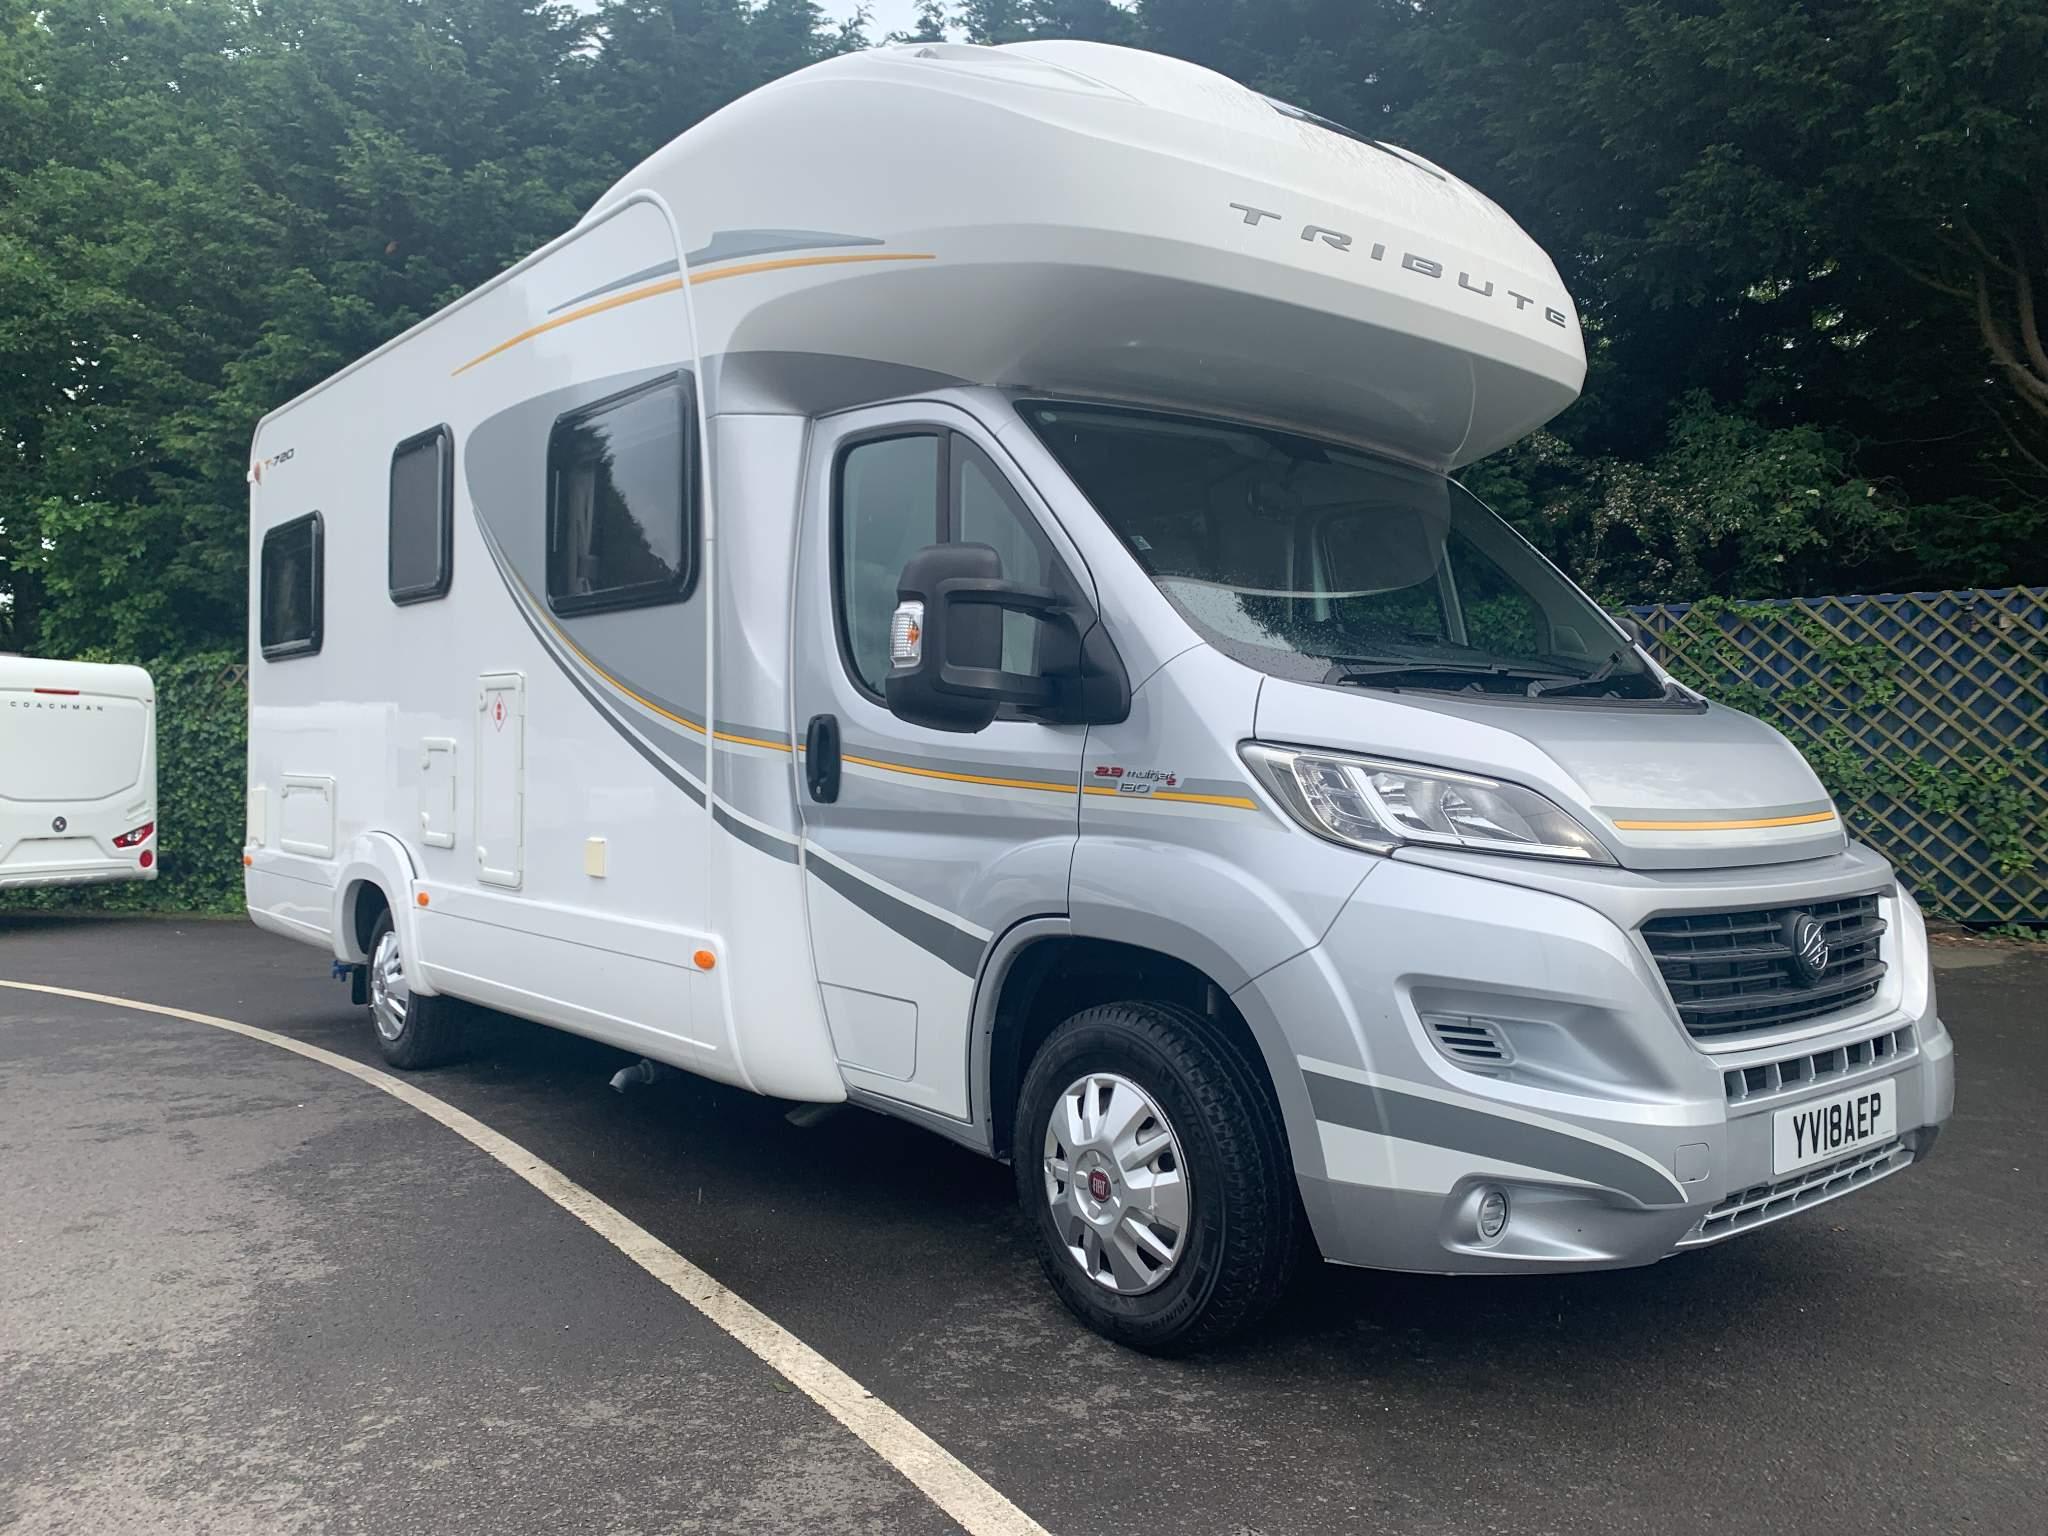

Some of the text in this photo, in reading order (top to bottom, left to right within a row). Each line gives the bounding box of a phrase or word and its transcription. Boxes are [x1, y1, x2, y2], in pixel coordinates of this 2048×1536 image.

[1229, 203, 1566, 328] TRIBUTE
[10, 701, 104, 712] COACHMAN
[1793, 1092, 1881, 1159] YV18AEP
[1092, 1177, 1106, 1196] FIAT
